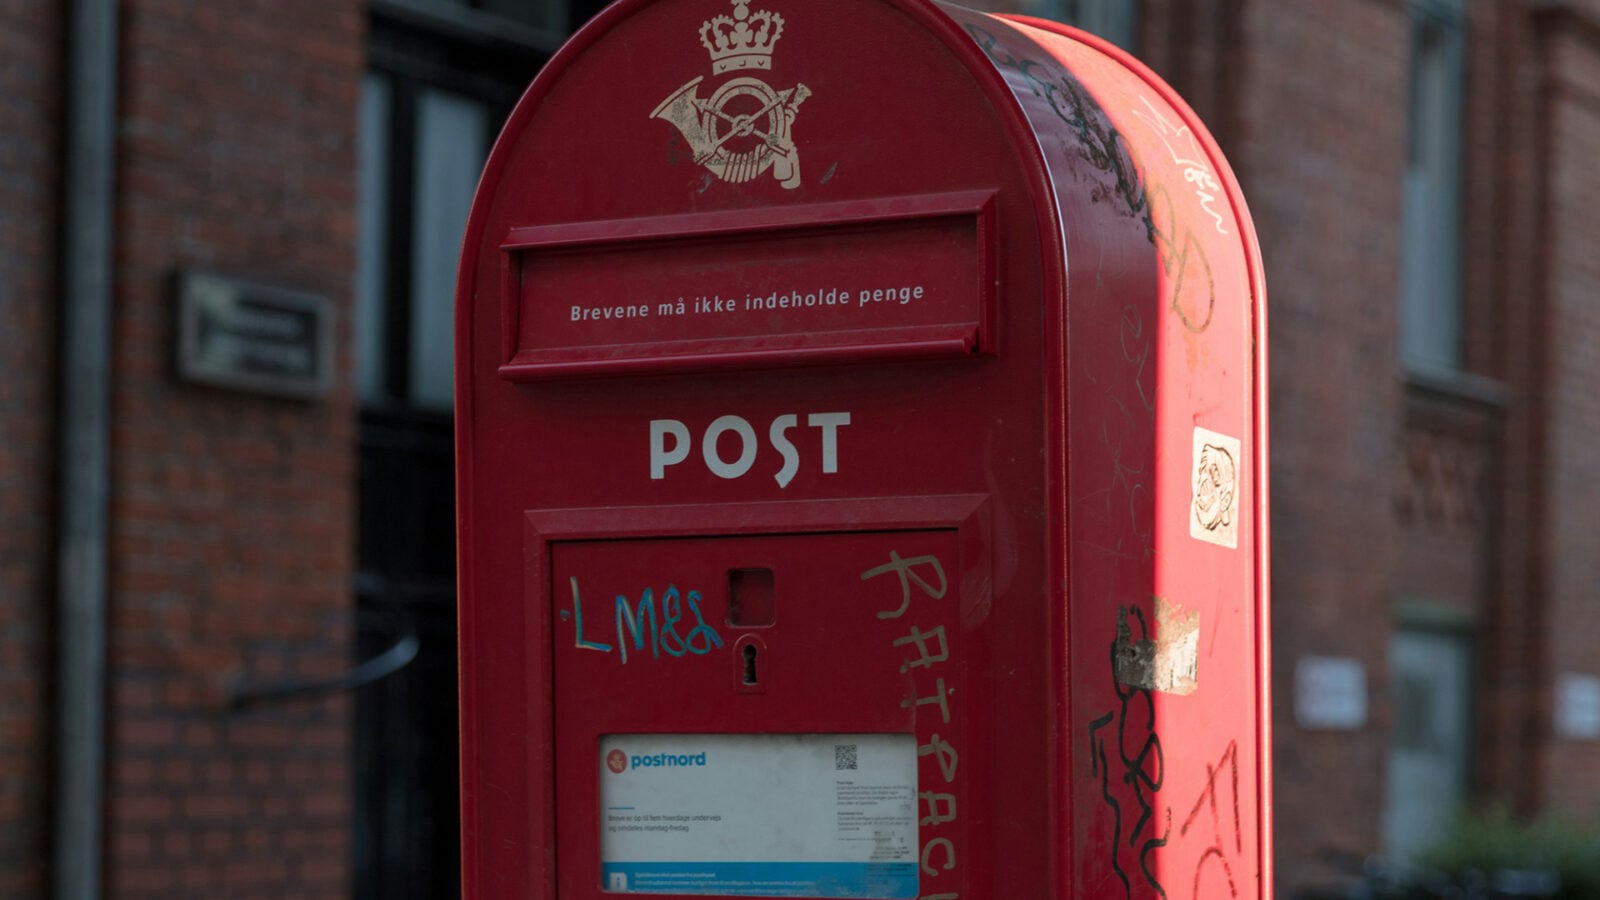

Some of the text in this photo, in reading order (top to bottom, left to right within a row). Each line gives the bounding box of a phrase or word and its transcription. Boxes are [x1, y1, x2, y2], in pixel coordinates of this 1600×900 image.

[570, 286, 924, 321] Brevene må ikke indeholde penge
[650, 412, 851, 489] POST
[631, 752, 706, 769] postnord
